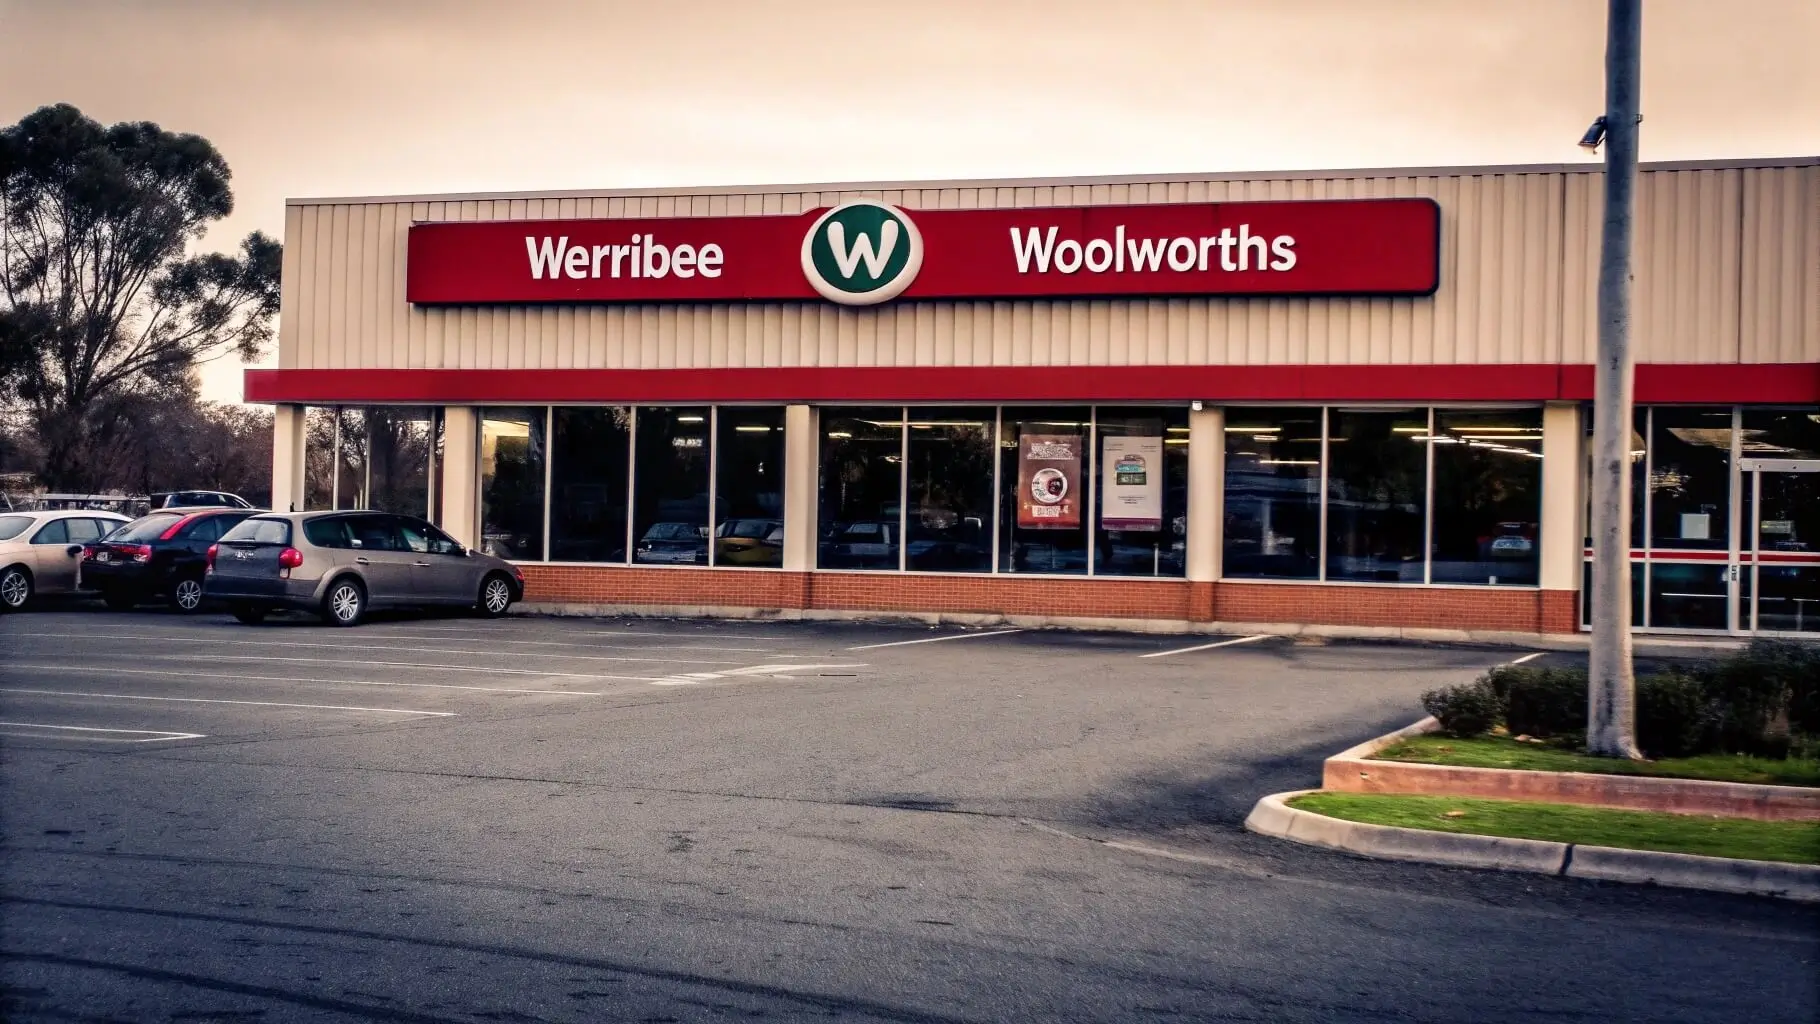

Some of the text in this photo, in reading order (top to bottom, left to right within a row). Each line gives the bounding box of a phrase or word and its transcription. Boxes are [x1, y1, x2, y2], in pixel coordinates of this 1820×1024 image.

[525, 234, 724, 280] Werribee
[827, 219, 899, 280] W
[1010, 223, 1297, 275] Woolworths
